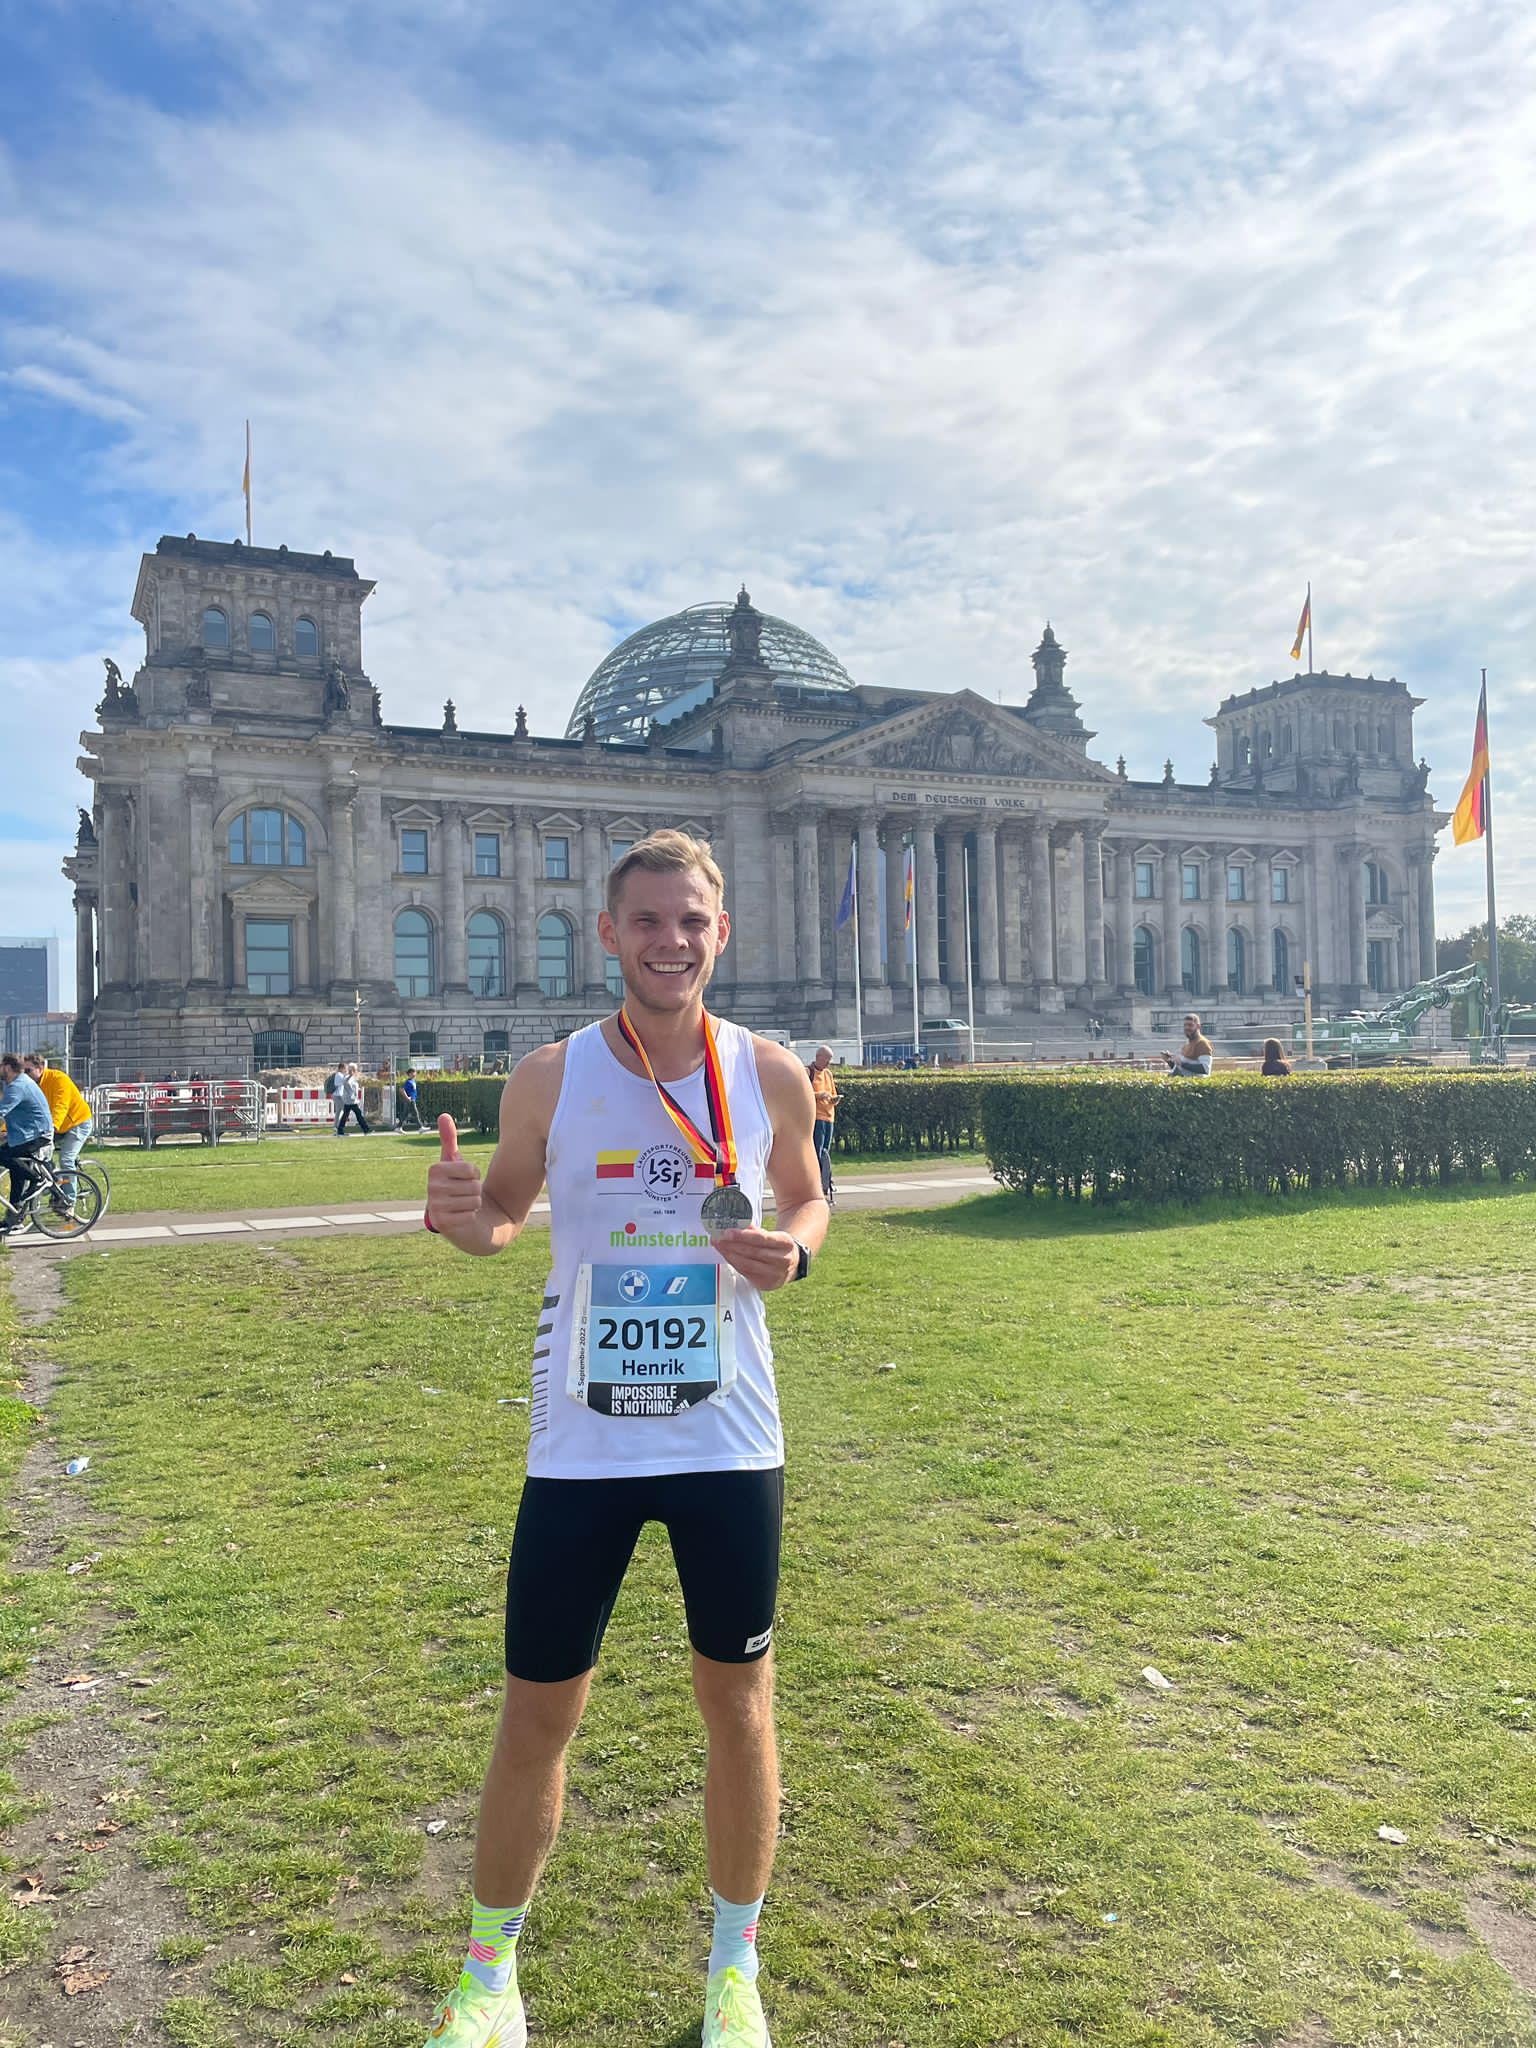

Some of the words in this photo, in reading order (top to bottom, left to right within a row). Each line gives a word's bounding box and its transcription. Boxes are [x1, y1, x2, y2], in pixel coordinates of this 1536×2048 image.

[892, 791, 917, 801] DEM
[925, 793, 987, 806] DEUTSCHEN
[994, 798, 1025, 808] VOLKE
[649, 1158, 682, 1188] LSF
[610, 1222, 710, 1248] Münsterlan
[723, 1310, 733, 1322] A
[598, 1317, 707, 1350] 20192
[578, 1347, 586, 1386] September
[622, 1359, 685, 1376] Henrik
[611, 1385, 677, 1400] IMPOSSIBLE
[611, 1400, 622, 1414] IS
[624, 1400, 673, 1415] NOTHING
